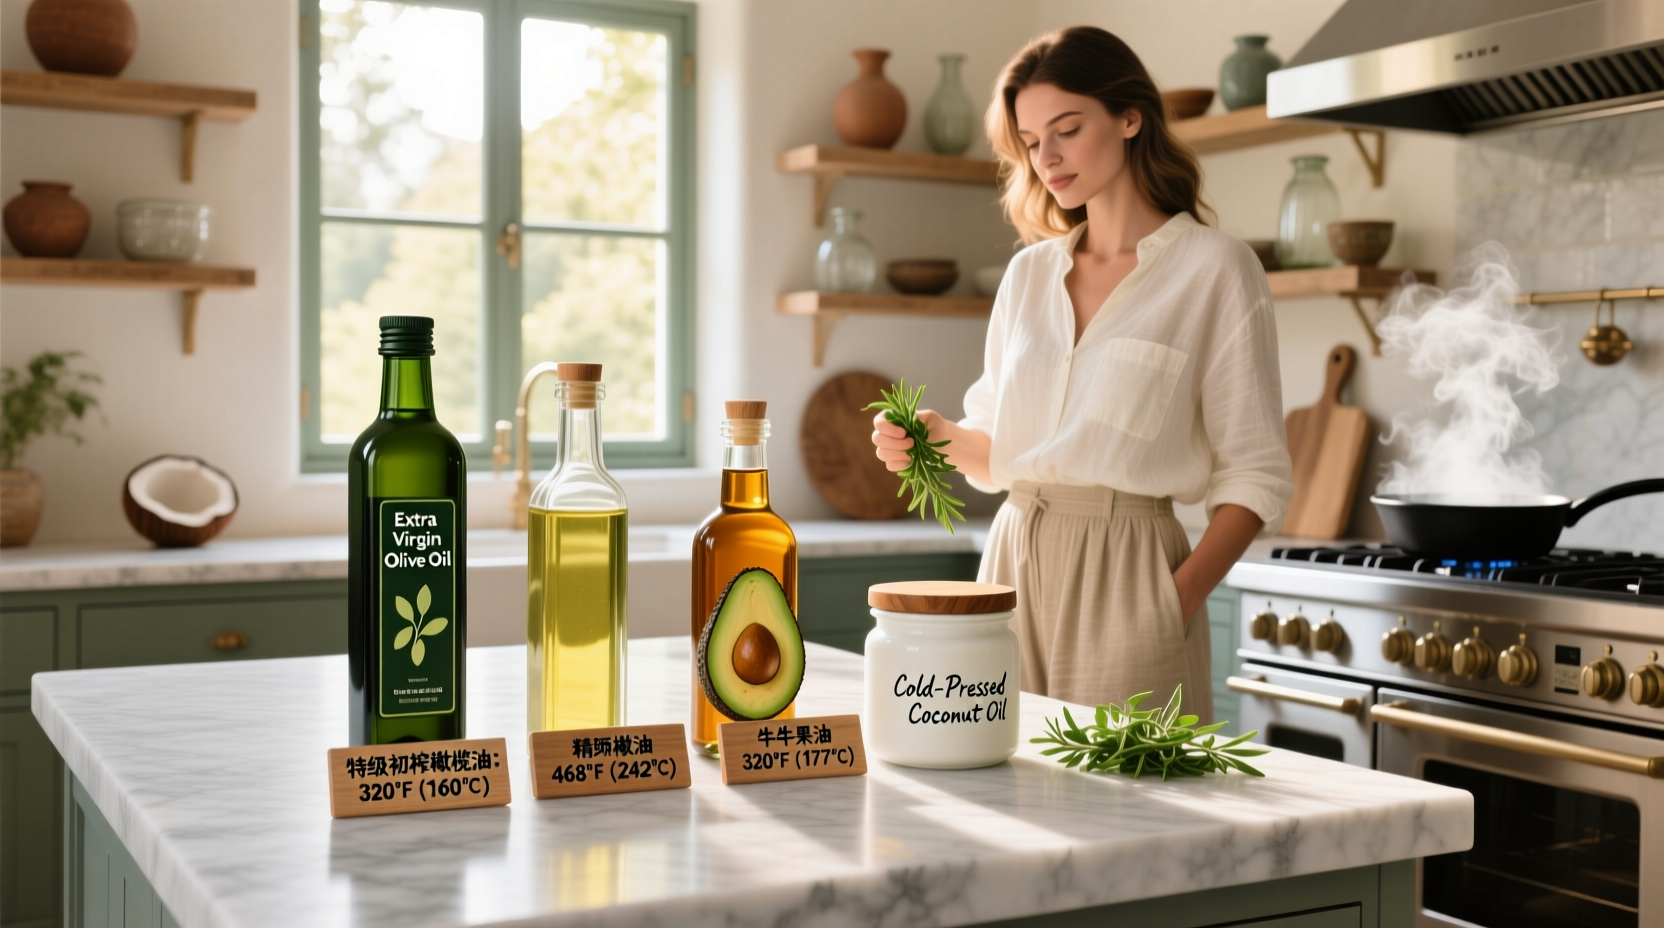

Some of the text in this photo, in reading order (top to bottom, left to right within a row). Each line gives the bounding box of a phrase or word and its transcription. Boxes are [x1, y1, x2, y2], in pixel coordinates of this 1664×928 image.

[394, 512, 438, 528] Extra
[392, 531, 442, 551] Virgin
[384, 550, 452, 569] Olive Oil
[893, 671, 1007, 699] Cold-Pressed
[908, 697, 1008, 725] Coconut Oil
